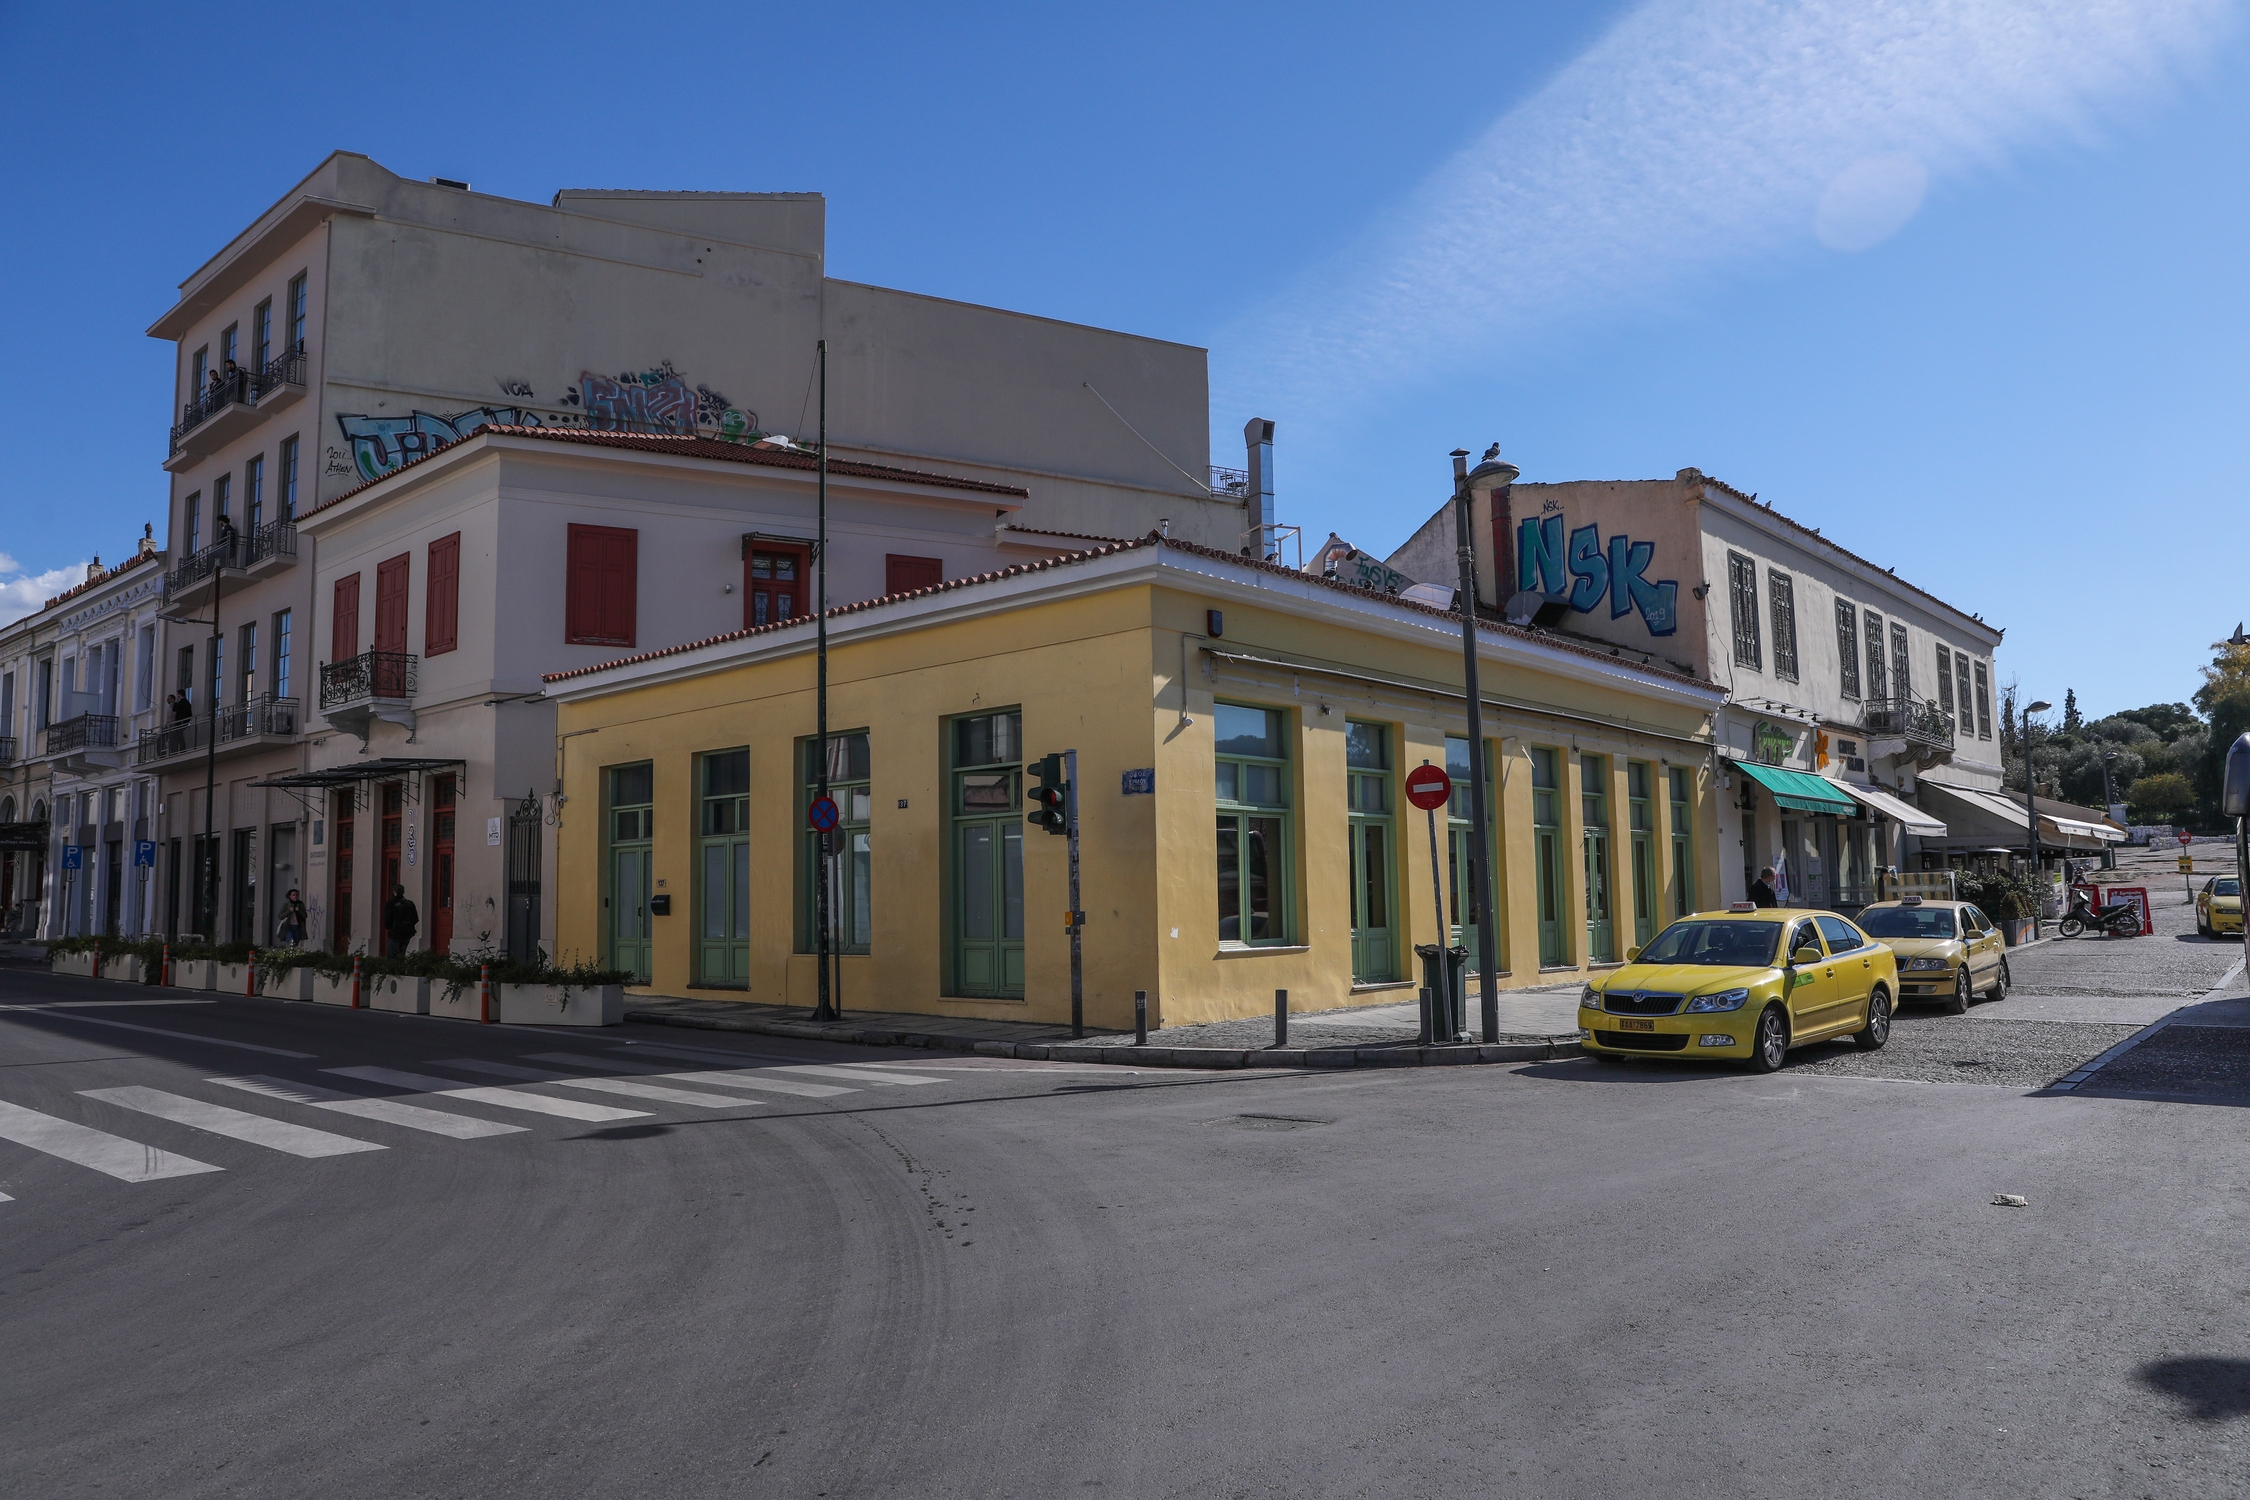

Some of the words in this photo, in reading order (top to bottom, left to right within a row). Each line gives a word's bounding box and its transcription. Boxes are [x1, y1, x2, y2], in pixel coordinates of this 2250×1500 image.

[1517, 513, 1678, 636] NSK
[1645, 607, 1666, 621] 2019
[67, 847, 79, 858] P
[140, 842, 152, 854] P
